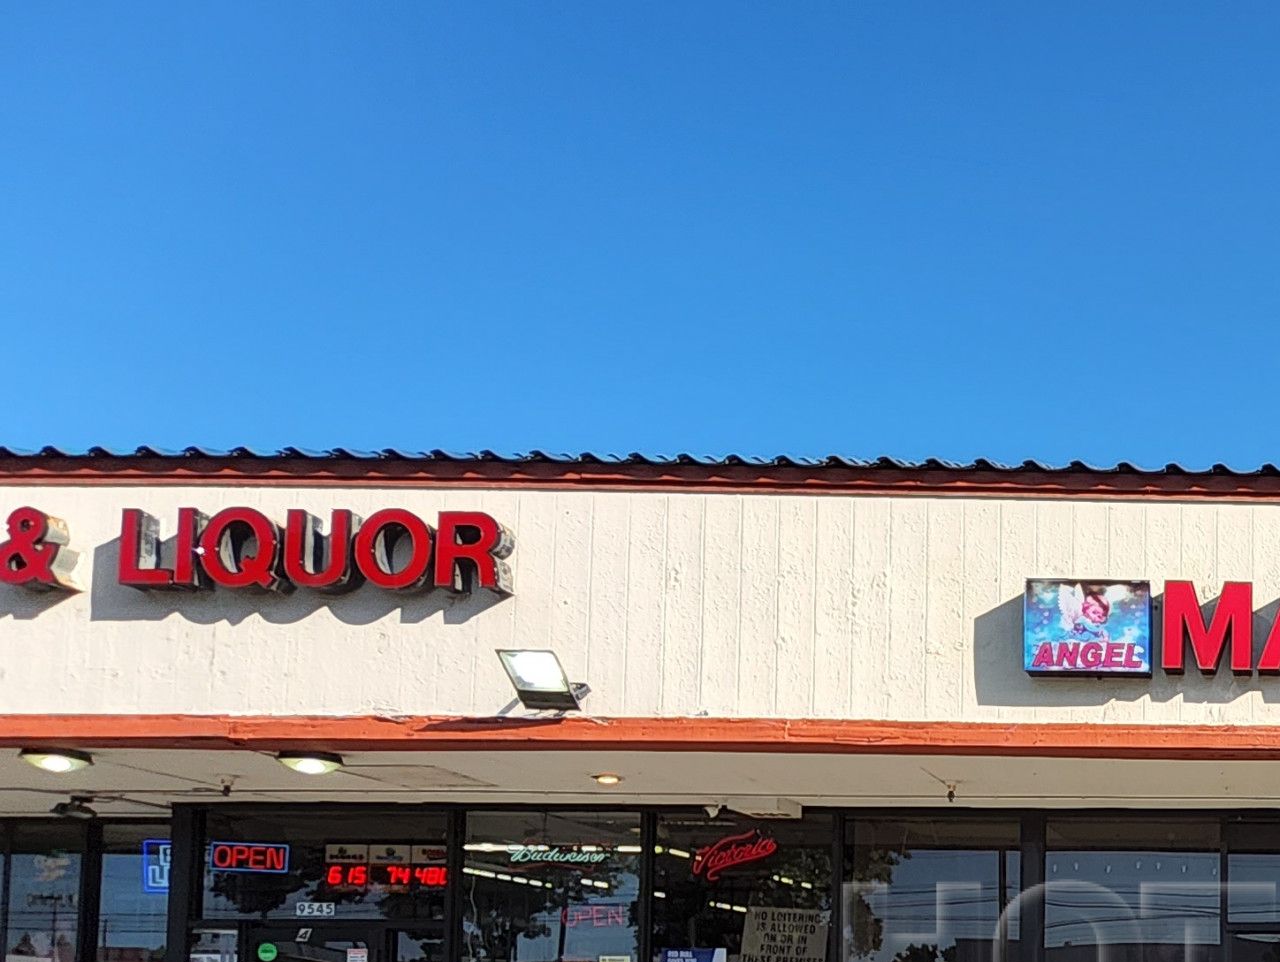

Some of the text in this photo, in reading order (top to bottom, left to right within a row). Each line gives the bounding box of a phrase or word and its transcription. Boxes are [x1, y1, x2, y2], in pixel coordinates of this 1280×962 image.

[0, 506, 500, 591] & LIQUOR
[1034, 641, 1143, 669] ANGEL
[213, 845, 285, 870] OPEN
[506, 846, 612, 863] Budweiser
[297, 903, 335, 915] 9545
[754, 911, 768, 921] NO
[561, 906, 623, 928] OPEN
[769, 923, 816, 934] ALLOWED
[797, 934, 808, 945] IN
[760, 944, 808, 956] FRONT OF
